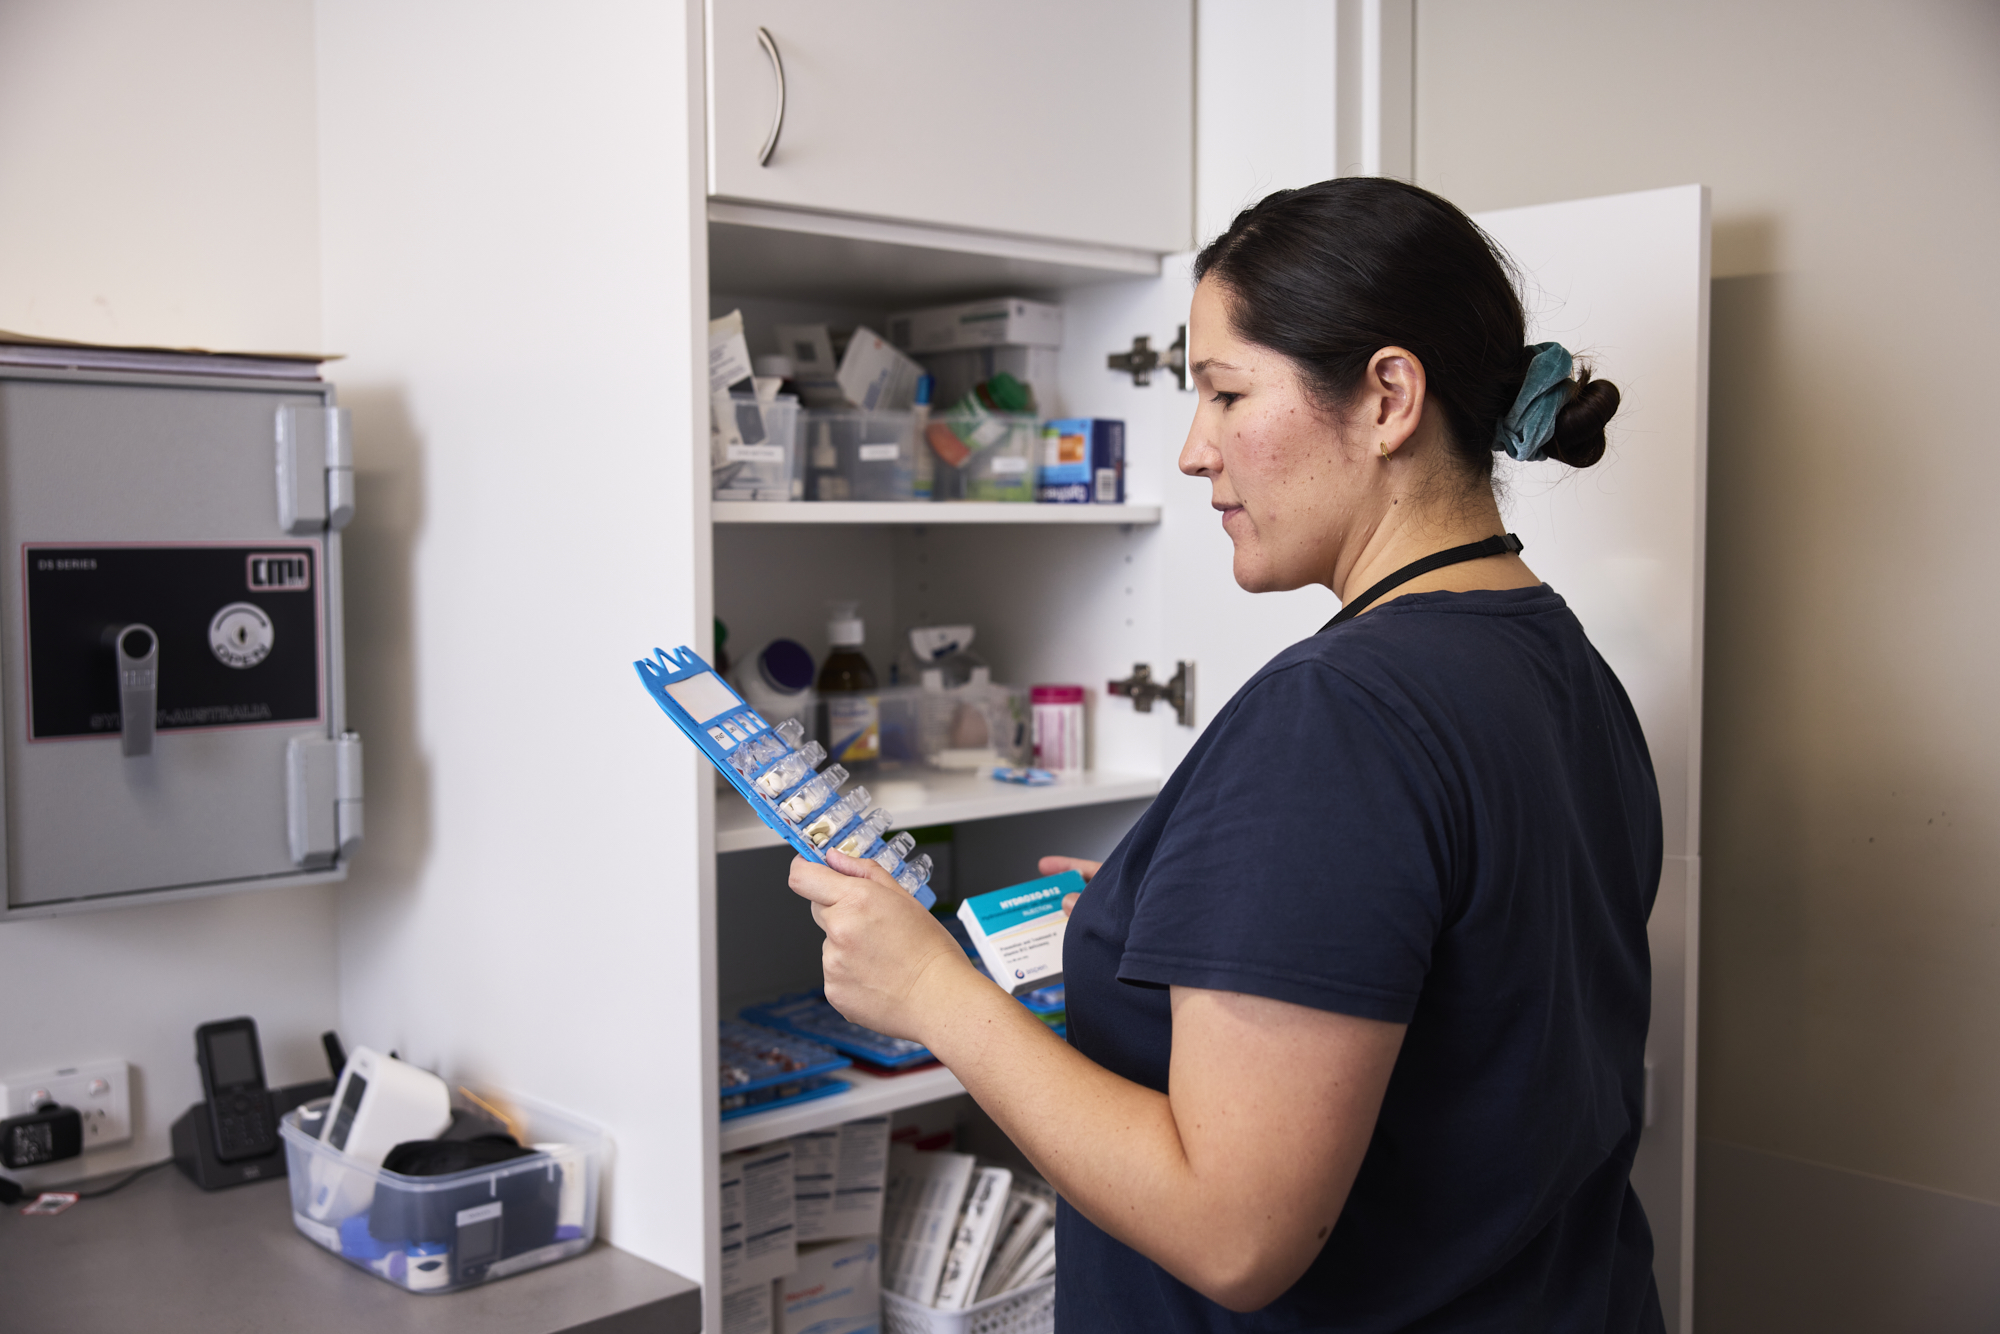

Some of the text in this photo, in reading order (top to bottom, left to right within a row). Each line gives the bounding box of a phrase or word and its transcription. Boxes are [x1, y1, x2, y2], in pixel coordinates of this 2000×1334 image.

[56, 558, 97, 571] SERIES
[215, 643, 269, 666] OPEN
[999, 886, 1061, 910] HYDROXO-B12
